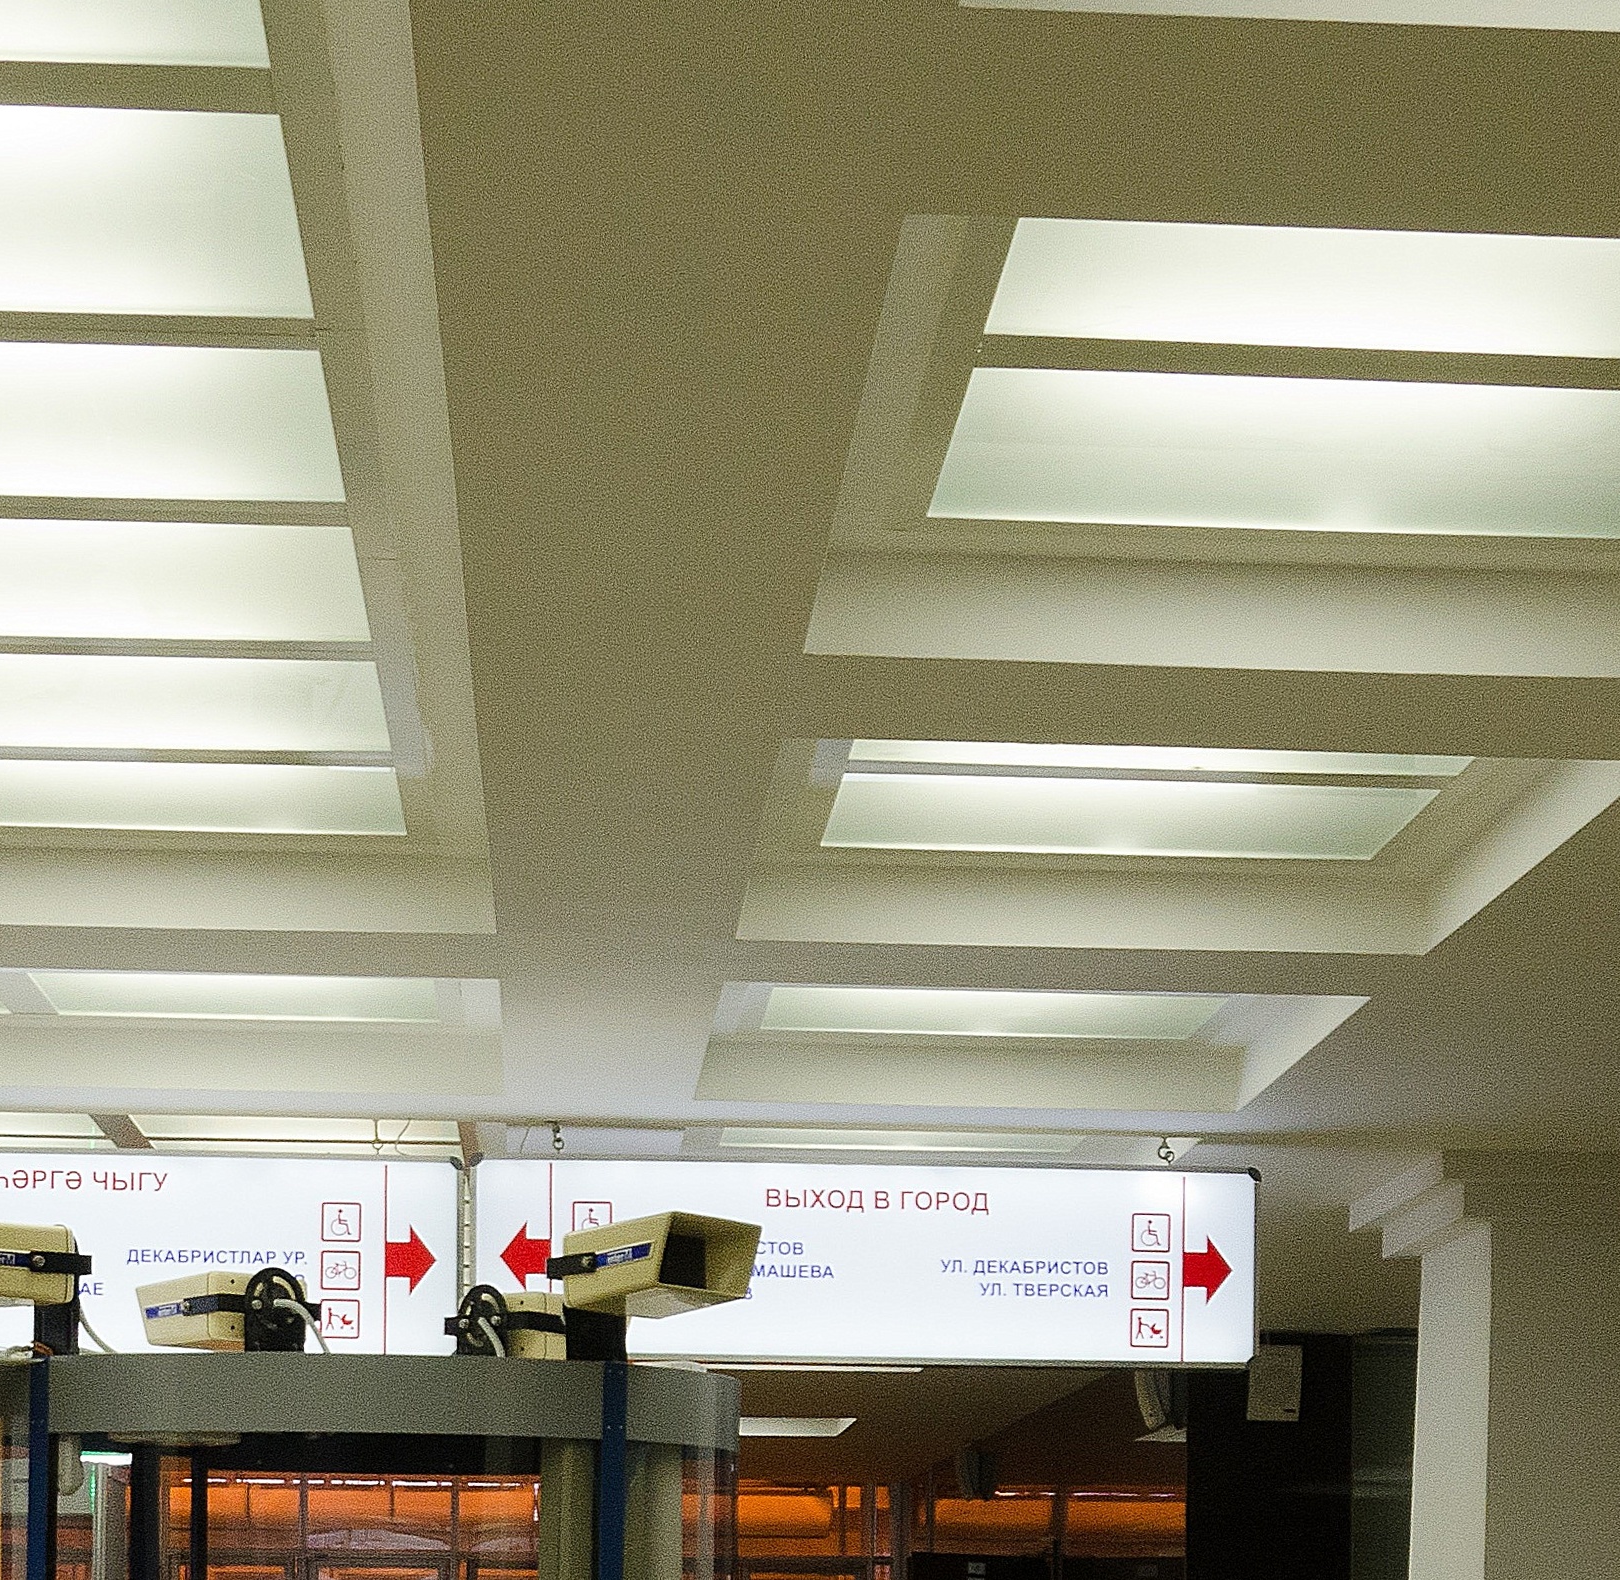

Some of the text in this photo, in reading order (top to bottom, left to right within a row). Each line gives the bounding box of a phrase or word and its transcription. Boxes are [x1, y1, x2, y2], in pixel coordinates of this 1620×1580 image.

[92, 1171, 168, 1192] ЧЫГУ
[765, 1188, 990, 1216] ВЫХОД В ГОРОД
[126, 1248, 308, 1265] ДЕКАБРИСТЛАР УР.
[757, 1241, 804, 1256] СТОВ
[751, 1264, 835, 1279] МАШЕВА
[940, 1259, 1110, 1276] УЛ. ДЕКАБРИСТОВ
[979, 1282, 1110, 1298] УЛ. ТВЕРСКАЯ
